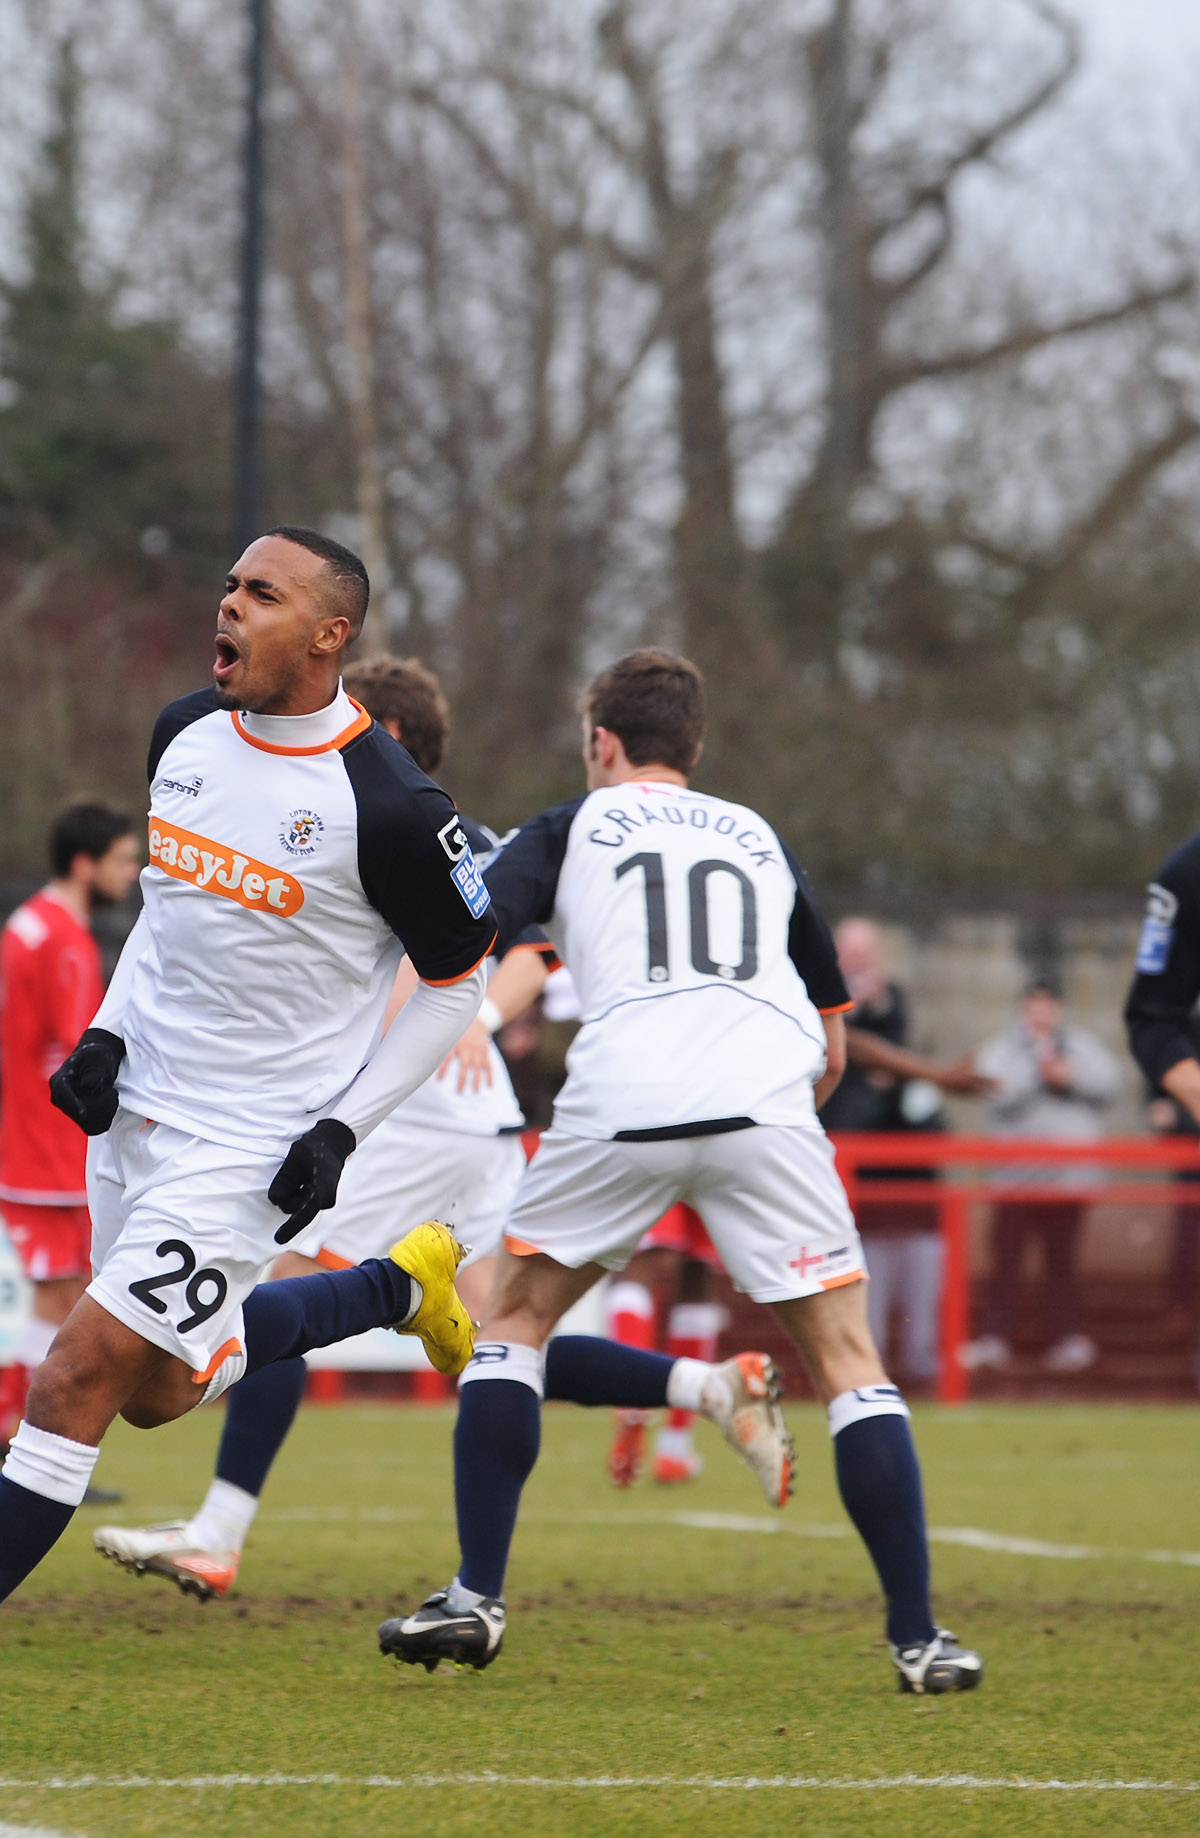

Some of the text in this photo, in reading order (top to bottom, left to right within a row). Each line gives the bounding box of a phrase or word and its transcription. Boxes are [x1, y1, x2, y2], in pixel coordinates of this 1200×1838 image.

[149, 829, 291, 909] easyJet
[588, 803, 780, 868] CRADDOCK
[615, 852, 758, 983] 10
[128, 1239, 228, 1334] 29
